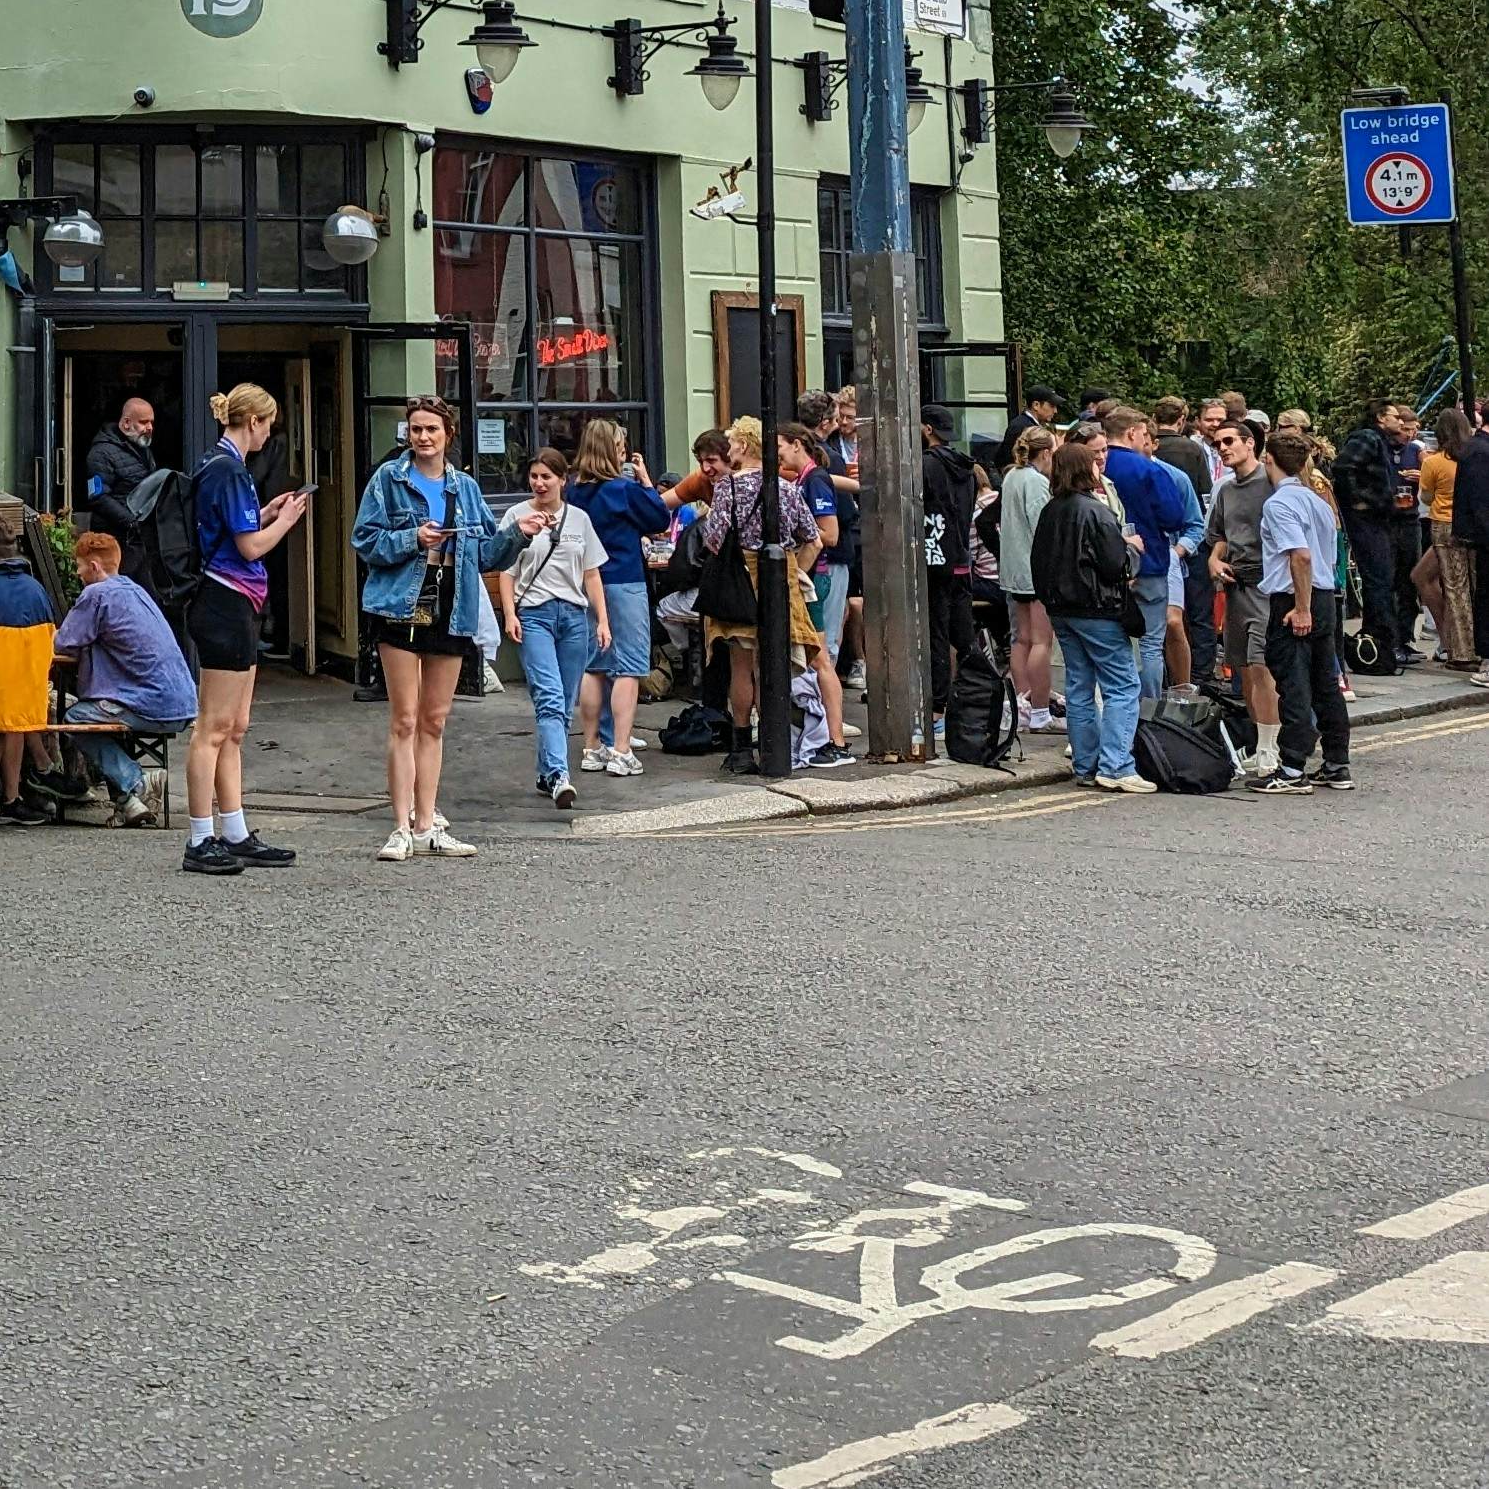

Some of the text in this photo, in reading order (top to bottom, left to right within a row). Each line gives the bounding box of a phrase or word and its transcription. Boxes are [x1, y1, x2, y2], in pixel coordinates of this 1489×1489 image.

[919, 1, 940, 17] Street
[1351, 113, 1440, 130] Low bridge
[1371, 130, 1419, 144] ahead
[1380, 169, 1418, 181] 4.1 m
[537, 339, 554, 364] The
